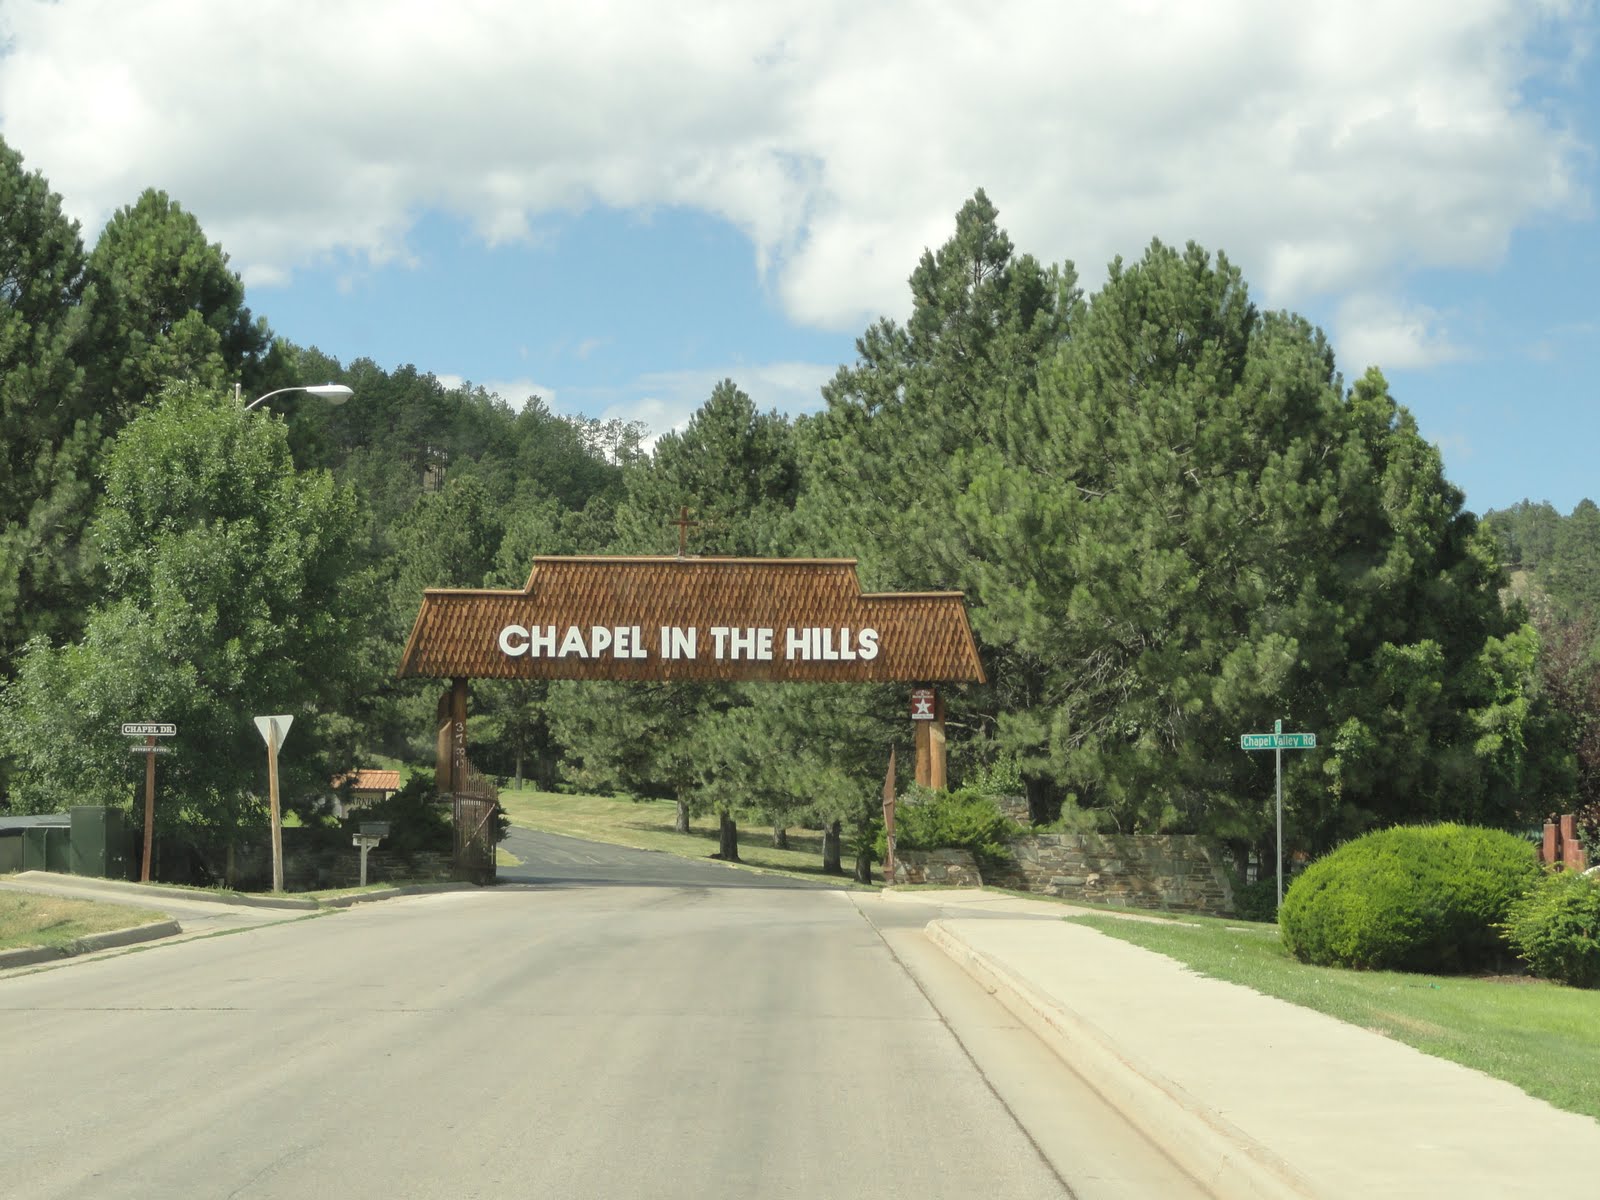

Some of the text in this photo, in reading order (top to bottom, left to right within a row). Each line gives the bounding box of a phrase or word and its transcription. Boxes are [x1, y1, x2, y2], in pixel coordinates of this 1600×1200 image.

[498, 624, 879, 661] CHAPEL IN THE HILLS
[124, 725, 175, 733] CHAPEL DR.
[1244, 734, 1315, 748] Chapel Valley Rd
